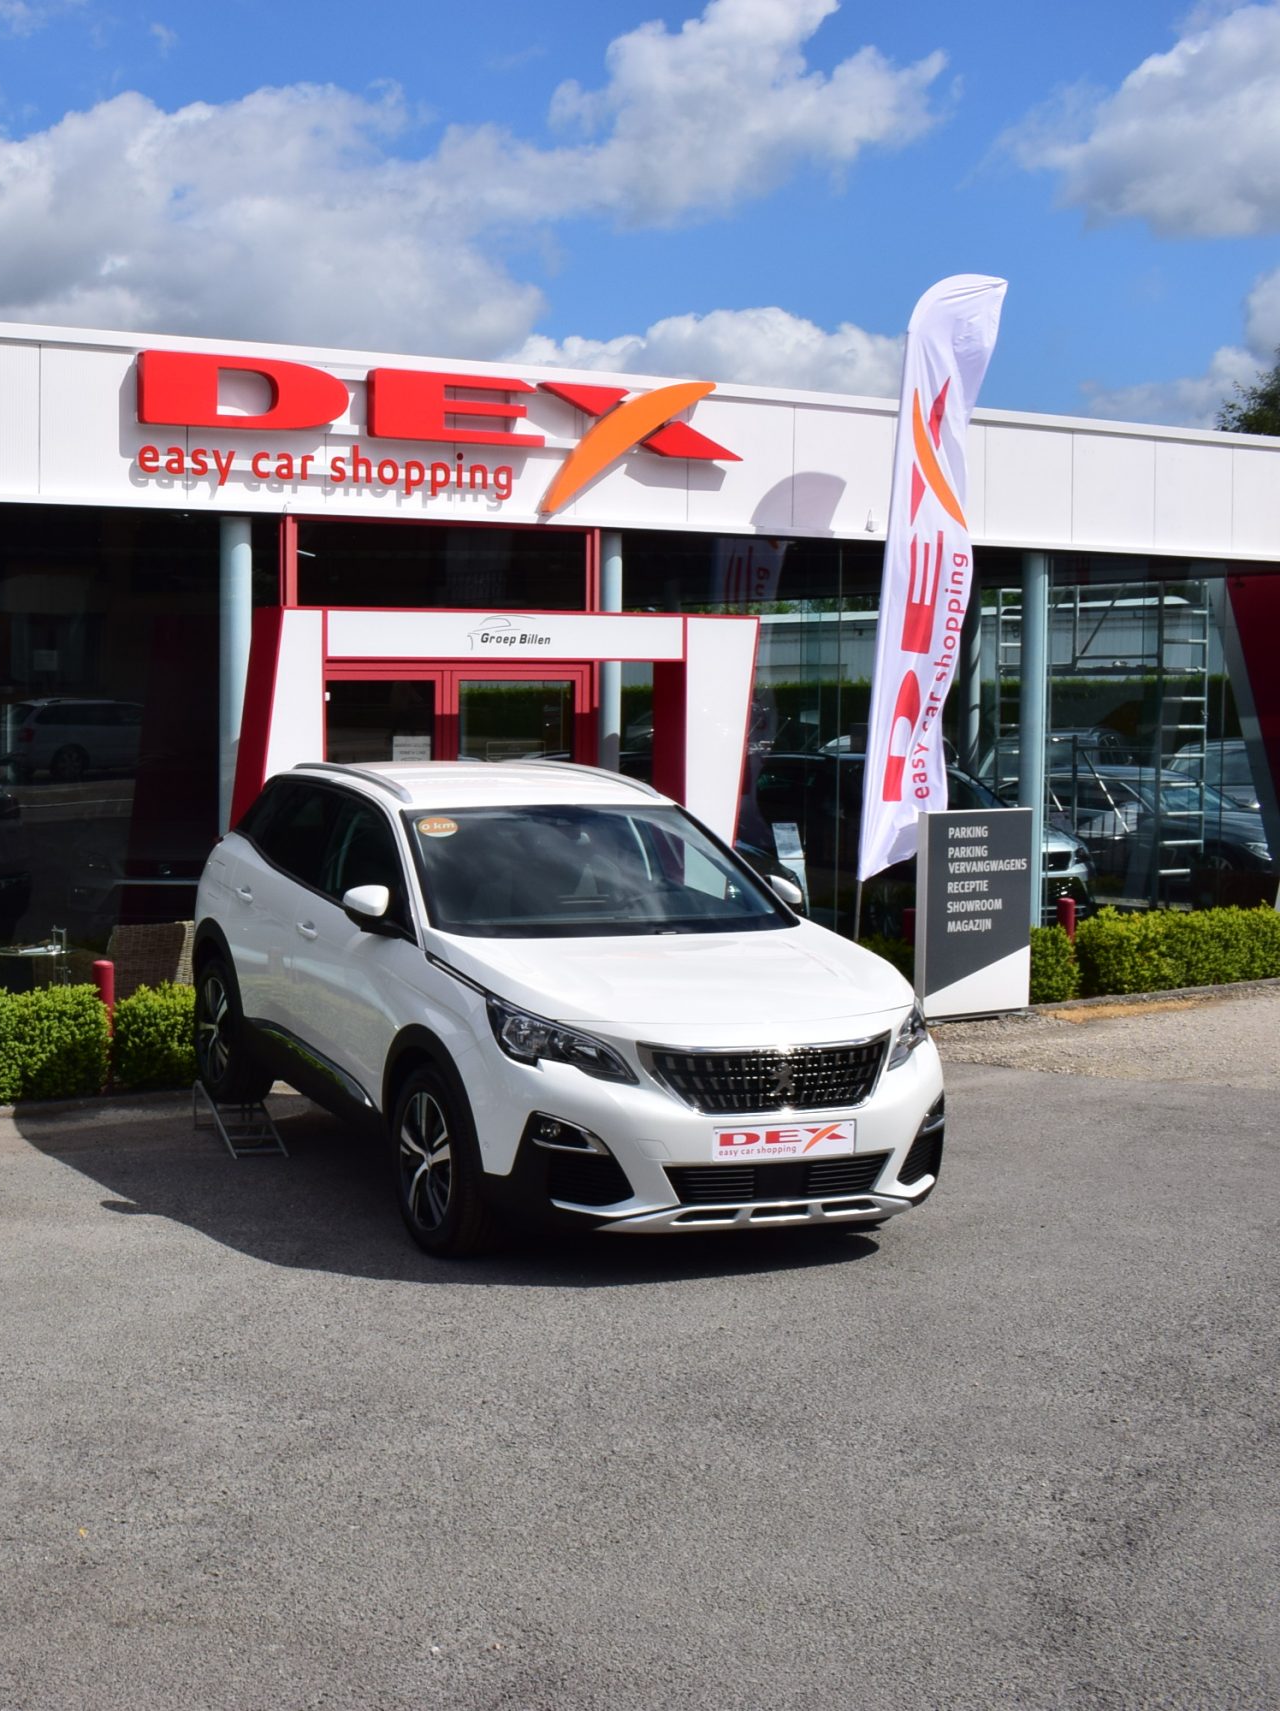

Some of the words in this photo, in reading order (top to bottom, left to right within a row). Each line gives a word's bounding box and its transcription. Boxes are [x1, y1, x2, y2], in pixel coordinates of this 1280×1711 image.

[136, 350, 744, 514] DEX
[137, 444, 235, 486] easy
[251, 449, 314, 481] car
[329, 444, 514, 500] shopping
[480, 632, 517, 647] Groep
[519, 633, 551, 645] Billen
[911, 741, 931, 800] easy
[933, 552, 969, 683] shopping
[433, 822, 456, 830] km
[948, 826, 989, 839] PARKING
[948, 845, 988, 859] PARKING
[948, 858, 1028, 874] VERVANGWAGENS
[947, 880, 989, 894] RECEPTIE
[946, 898, 1003, 913] SHOWROOM
[947, 918, 992, 933] MAGAZIJN
[719, 1123, 848, 1153] DEX
[718, 1149, 738, 1157] easy
[740, 1147, 754, 1155] car
[756, 1144, 797, 1154] shopping
